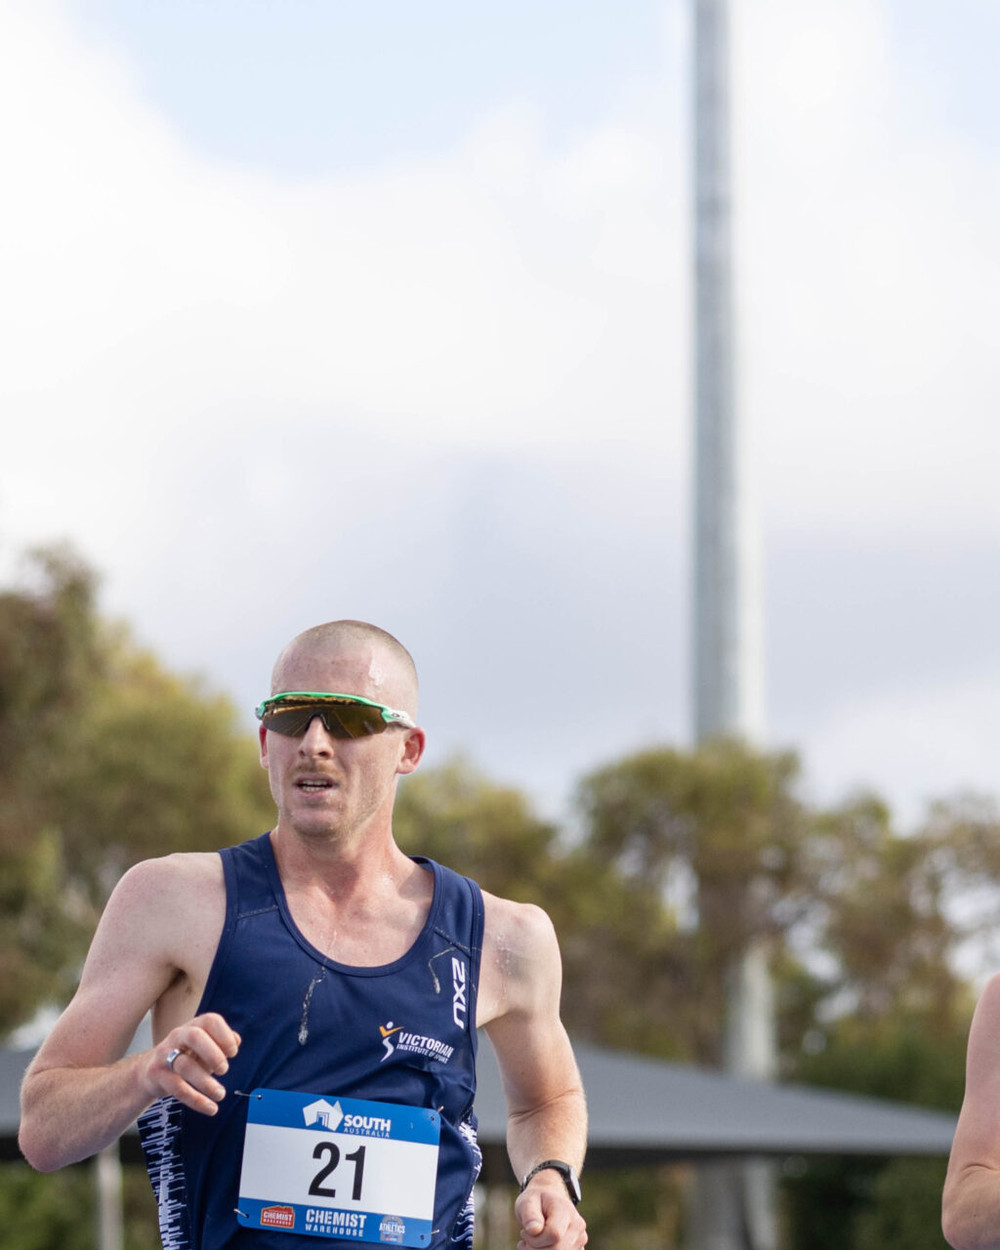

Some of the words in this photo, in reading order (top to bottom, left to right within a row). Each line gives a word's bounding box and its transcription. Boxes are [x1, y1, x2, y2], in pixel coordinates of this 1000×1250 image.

[452, 957, 466, 1030] 2XU
[399, 1032, 454, 1058] VICTORIAN
[344, 1114, 391, 1131] SOUTH
[344, 1128, 390, 1138] AUSTRALIA
[308, 1142, 366, 1201] 21
[263, 1211, 293, 1222] CHEMIST
[306, 1209, 367, 1229] CHEMIST
[305, 1223, 364, 1237] WAREHOUSE
[379, 1222, 406, 1234] ATHLETICS
